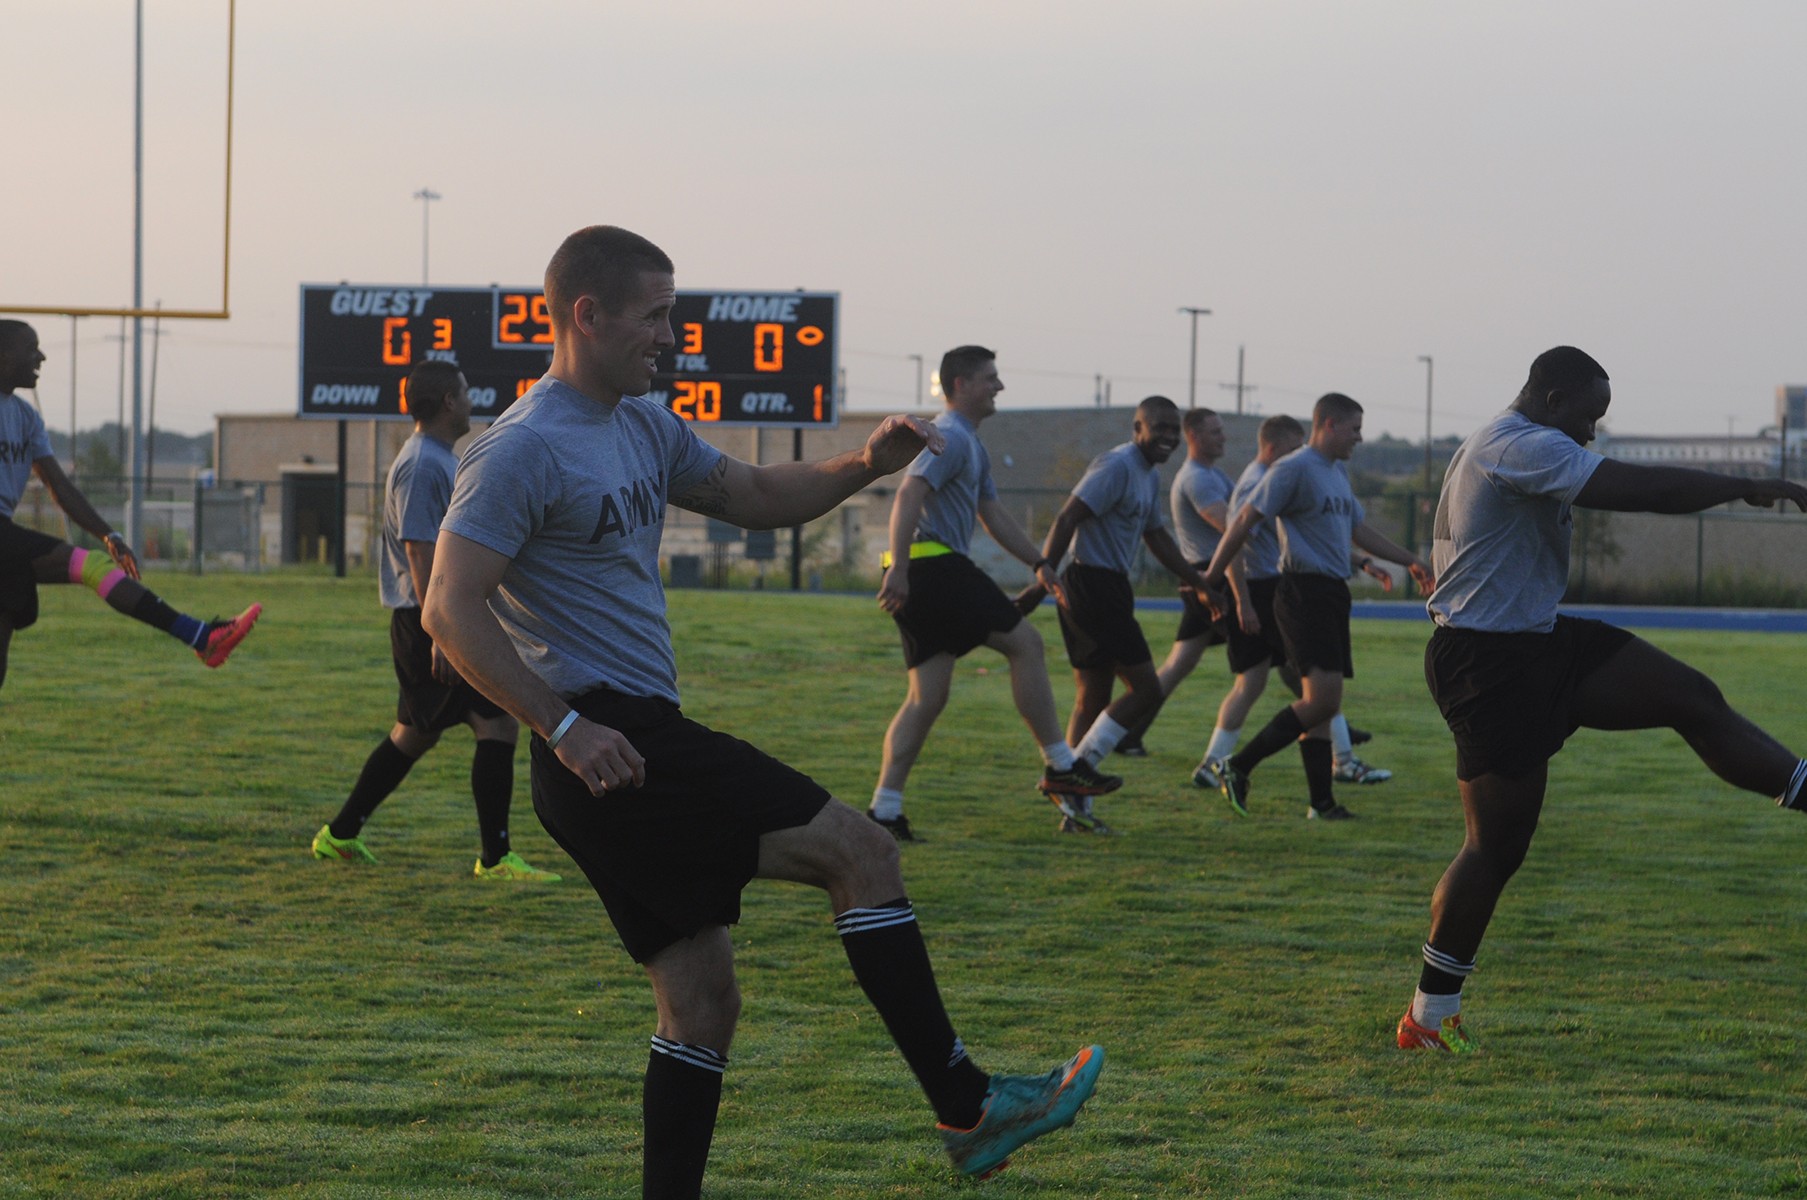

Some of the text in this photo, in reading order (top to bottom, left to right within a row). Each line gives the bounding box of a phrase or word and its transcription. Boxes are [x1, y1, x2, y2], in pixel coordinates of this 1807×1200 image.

[330, 290, 433, 317] GUEST
[707, 296, 802, 322] HOME
[432, 317, 453, 350] 3
[682, 322, 703, 354] 3
[753, 323, 784, 372] 0
[311, 384, 381, 405] DOWN
[671, 381, 722, 421] 20
[740, 384, 824, 421] QTR. 1
[587, 470, 663, 545] ARMY
